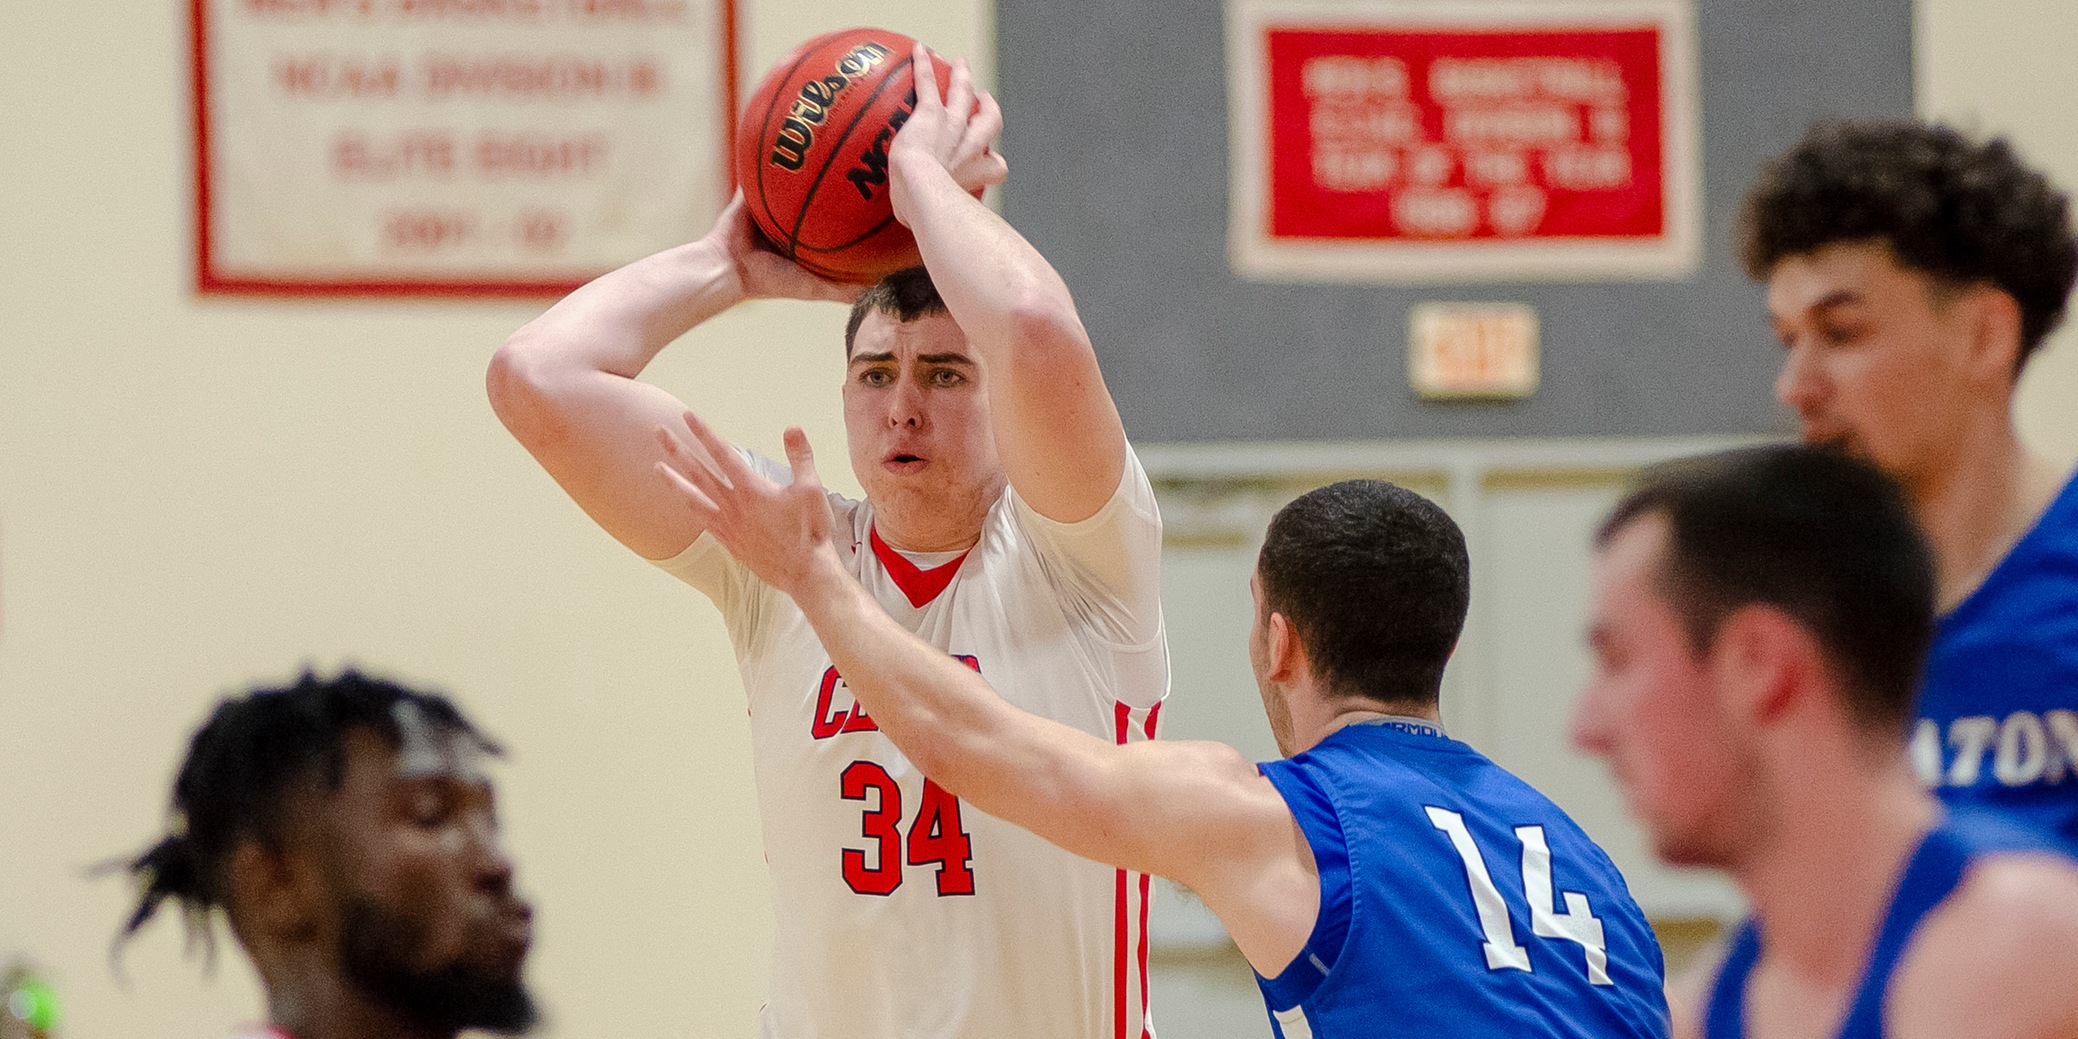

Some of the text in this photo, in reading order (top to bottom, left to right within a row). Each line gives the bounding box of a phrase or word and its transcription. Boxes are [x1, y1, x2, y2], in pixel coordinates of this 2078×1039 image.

[769, 41, 893, 174] Wilson
[840, 760, 976, 897] 34
[1424, 805, 1615, 986] 14
